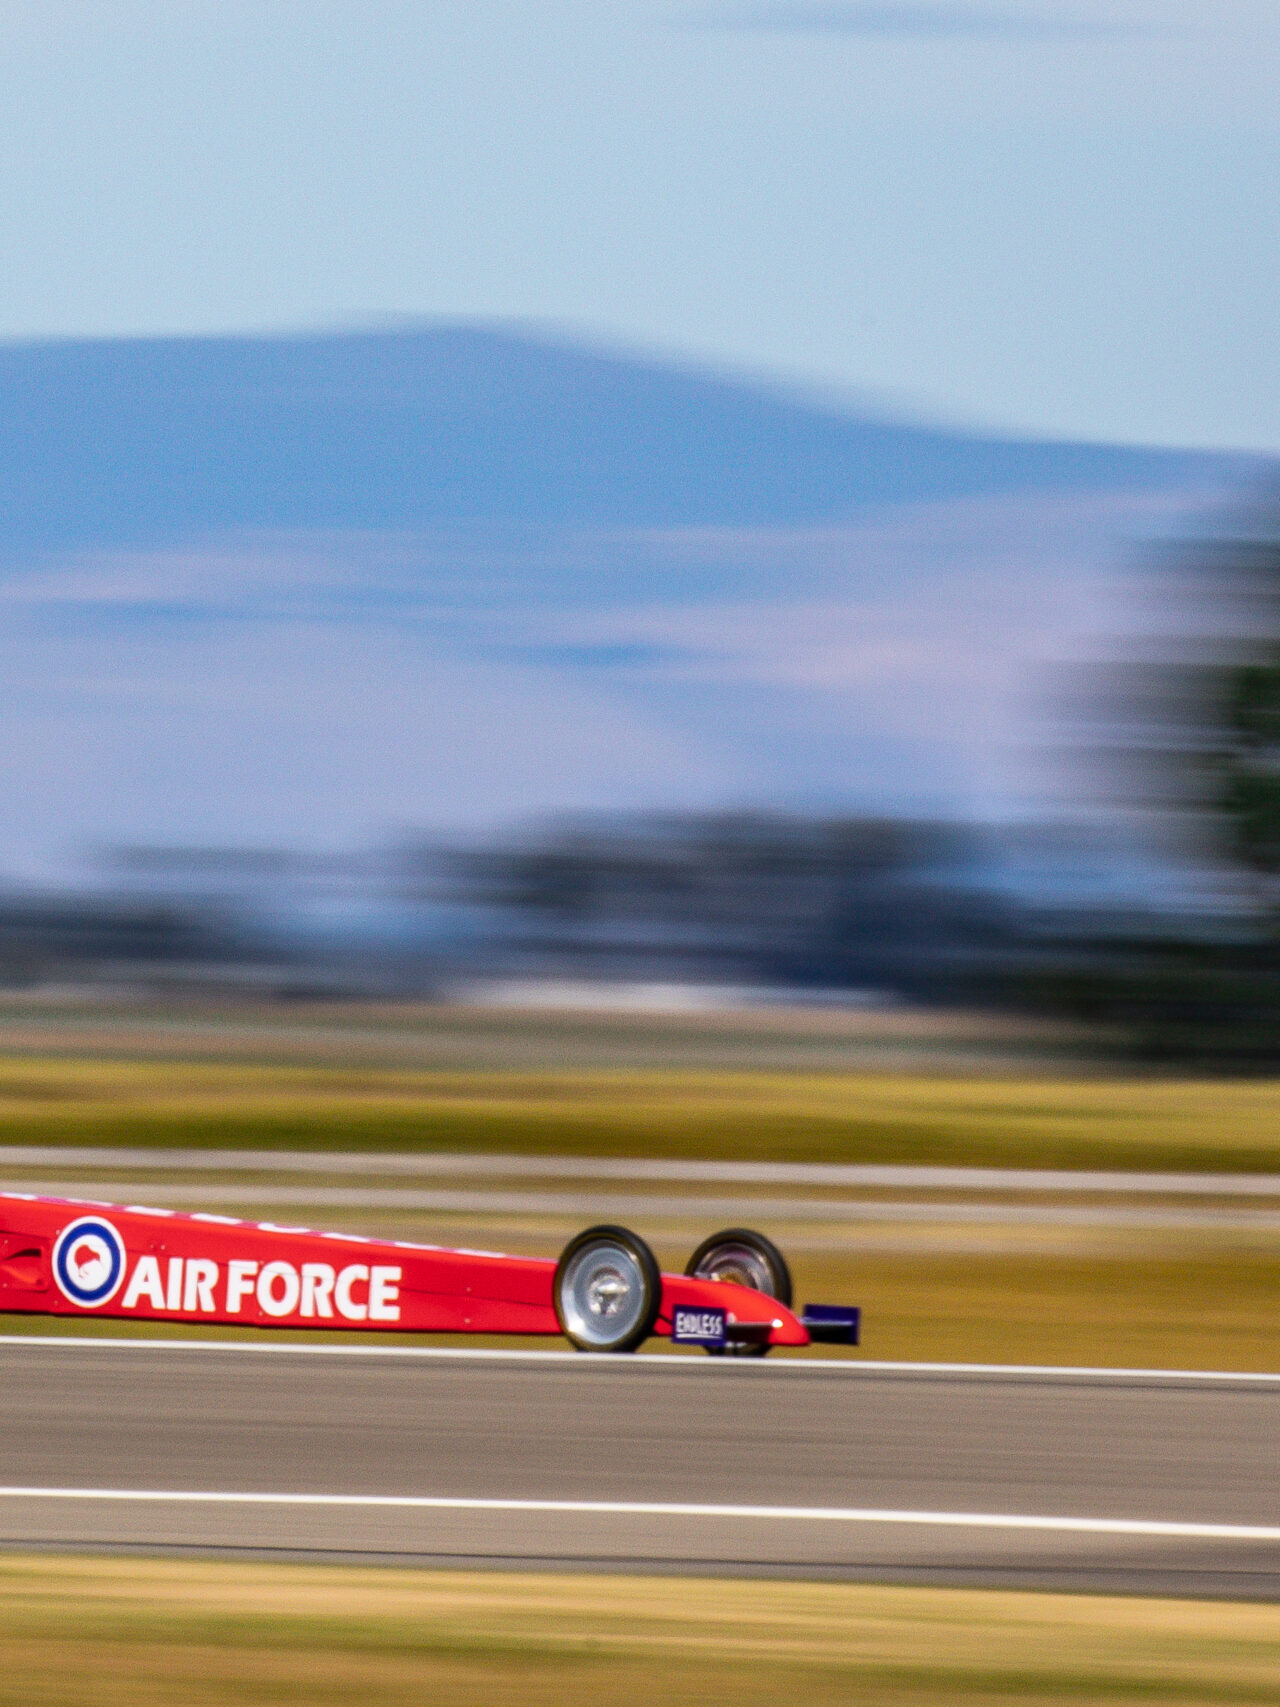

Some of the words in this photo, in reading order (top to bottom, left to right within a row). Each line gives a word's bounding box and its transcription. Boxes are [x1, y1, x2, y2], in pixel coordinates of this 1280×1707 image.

[121, 1255, 219, 1312] AIR
[226, 1260, 402, 1321] FORCE
[676, 1312, 723, 1335] ENDLESS
